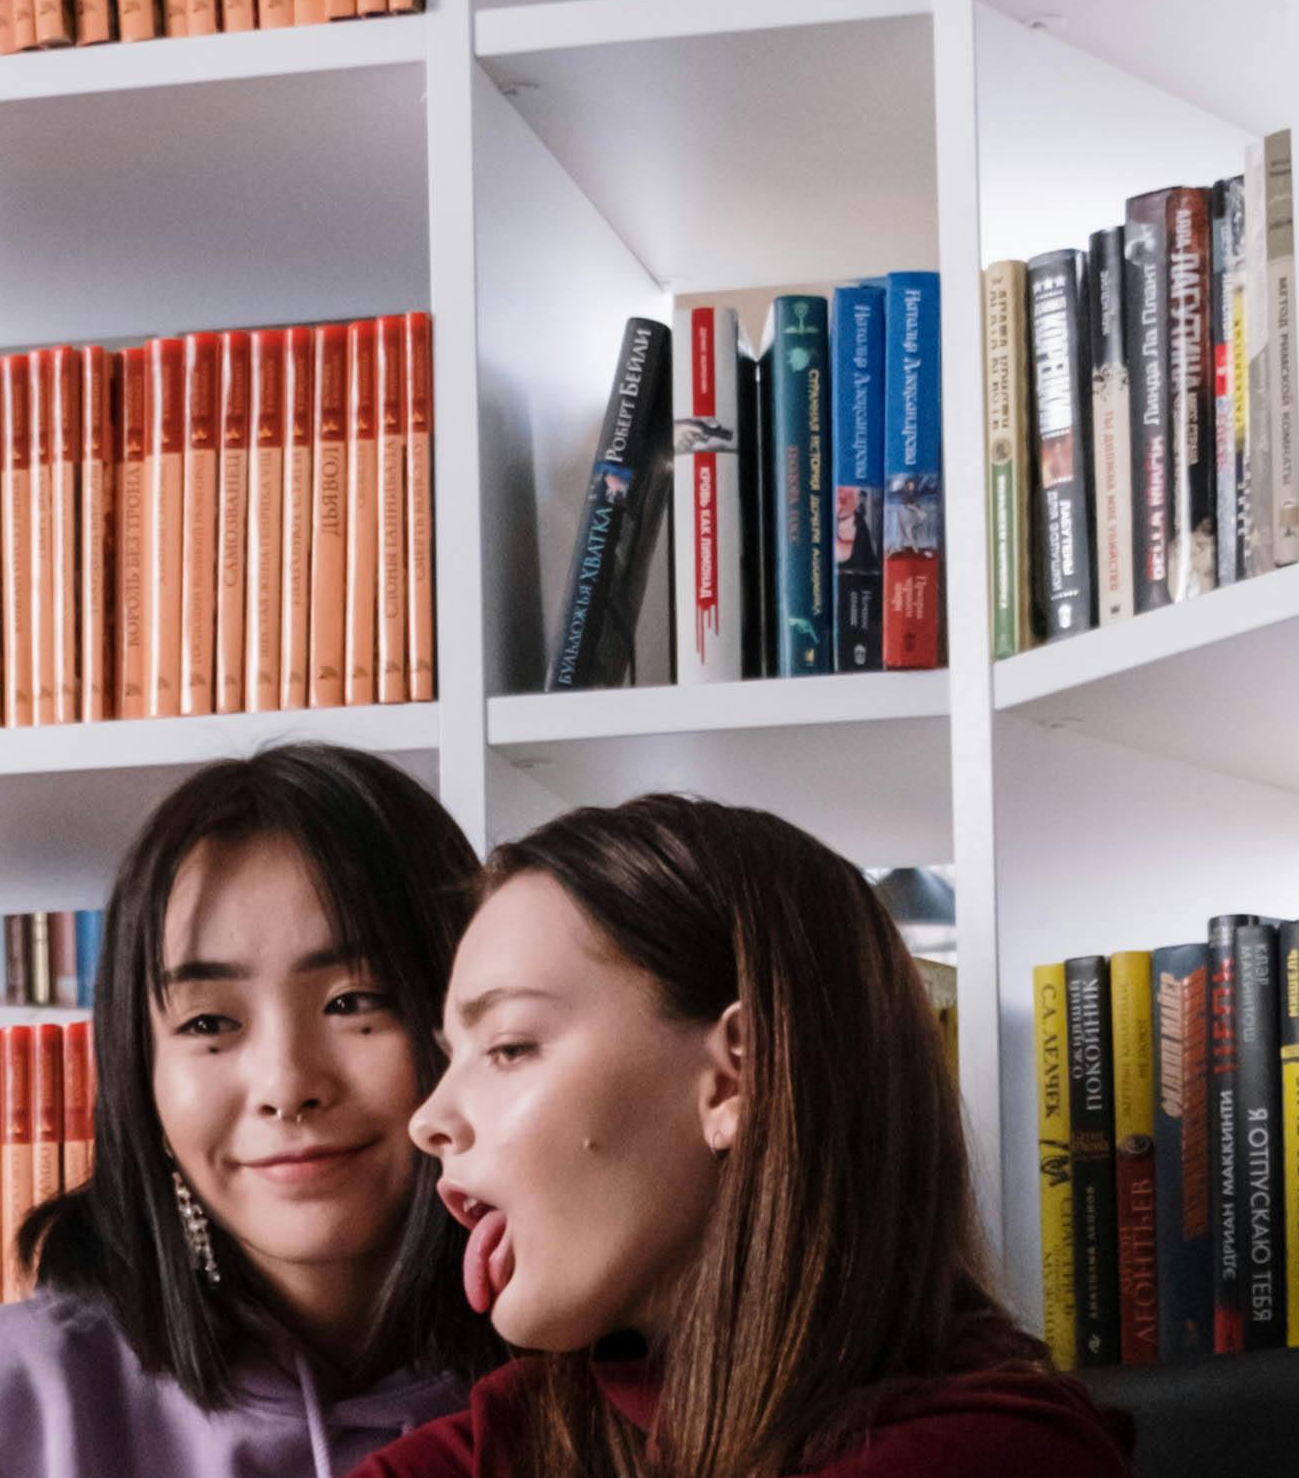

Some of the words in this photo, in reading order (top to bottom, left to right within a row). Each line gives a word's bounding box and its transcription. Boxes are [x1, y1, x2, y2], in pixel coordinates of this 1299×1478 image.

[898, 289, 923, 353] Наталья
[1141, 264, 1161, 324] Плант
[851, 304, 873, 368] Наталья
[605, 401, 629, 464] РОБЕРТ
[618, 326, 652, 396] БЕЙЛИ
[852, 371, 874, 480] Александрова
[901, 357, 922, 467] Александрова
[1142, 360, 1163, 426] Линда
[124, 467, 142, 530] ТРОНА
[223, 453, 244, 589] САМОЗВАНЕЦ
[319, 446, 342, 538] ДЬЯВОЛ
[699, 466, 712, 507] КРОВЬ
[699, 510, 712, 535] КАК
[125, 534, 142, 570] БЕЗ
[578, 505, 615, 581] ХВАТКА
[699, 538, 714, 598] ЛИМОНАД
[125, 574, 142, 649] КОРОЛЬ
[1241, 943, 1258, 1043] МАКИНТОШ
[1253, 942, 1270, 985] КЛЭР
[1082, 978, 1103, 1111] ПОКОЙНИК
[1218, 1088, 1236, 1199] МАККИНТИ
[1247, 1106, 1268, 1121] Я
[1246, 1127, 1271, 1265] ОТПУСКАЮ
[1132, 1178, 1157, 1344] ЛЕОНТЬЕВ
[1219, 1205, 1235, 1281] ЭДРИАН
[1251, 1270, 1273, 1323] ТЕБЯ
